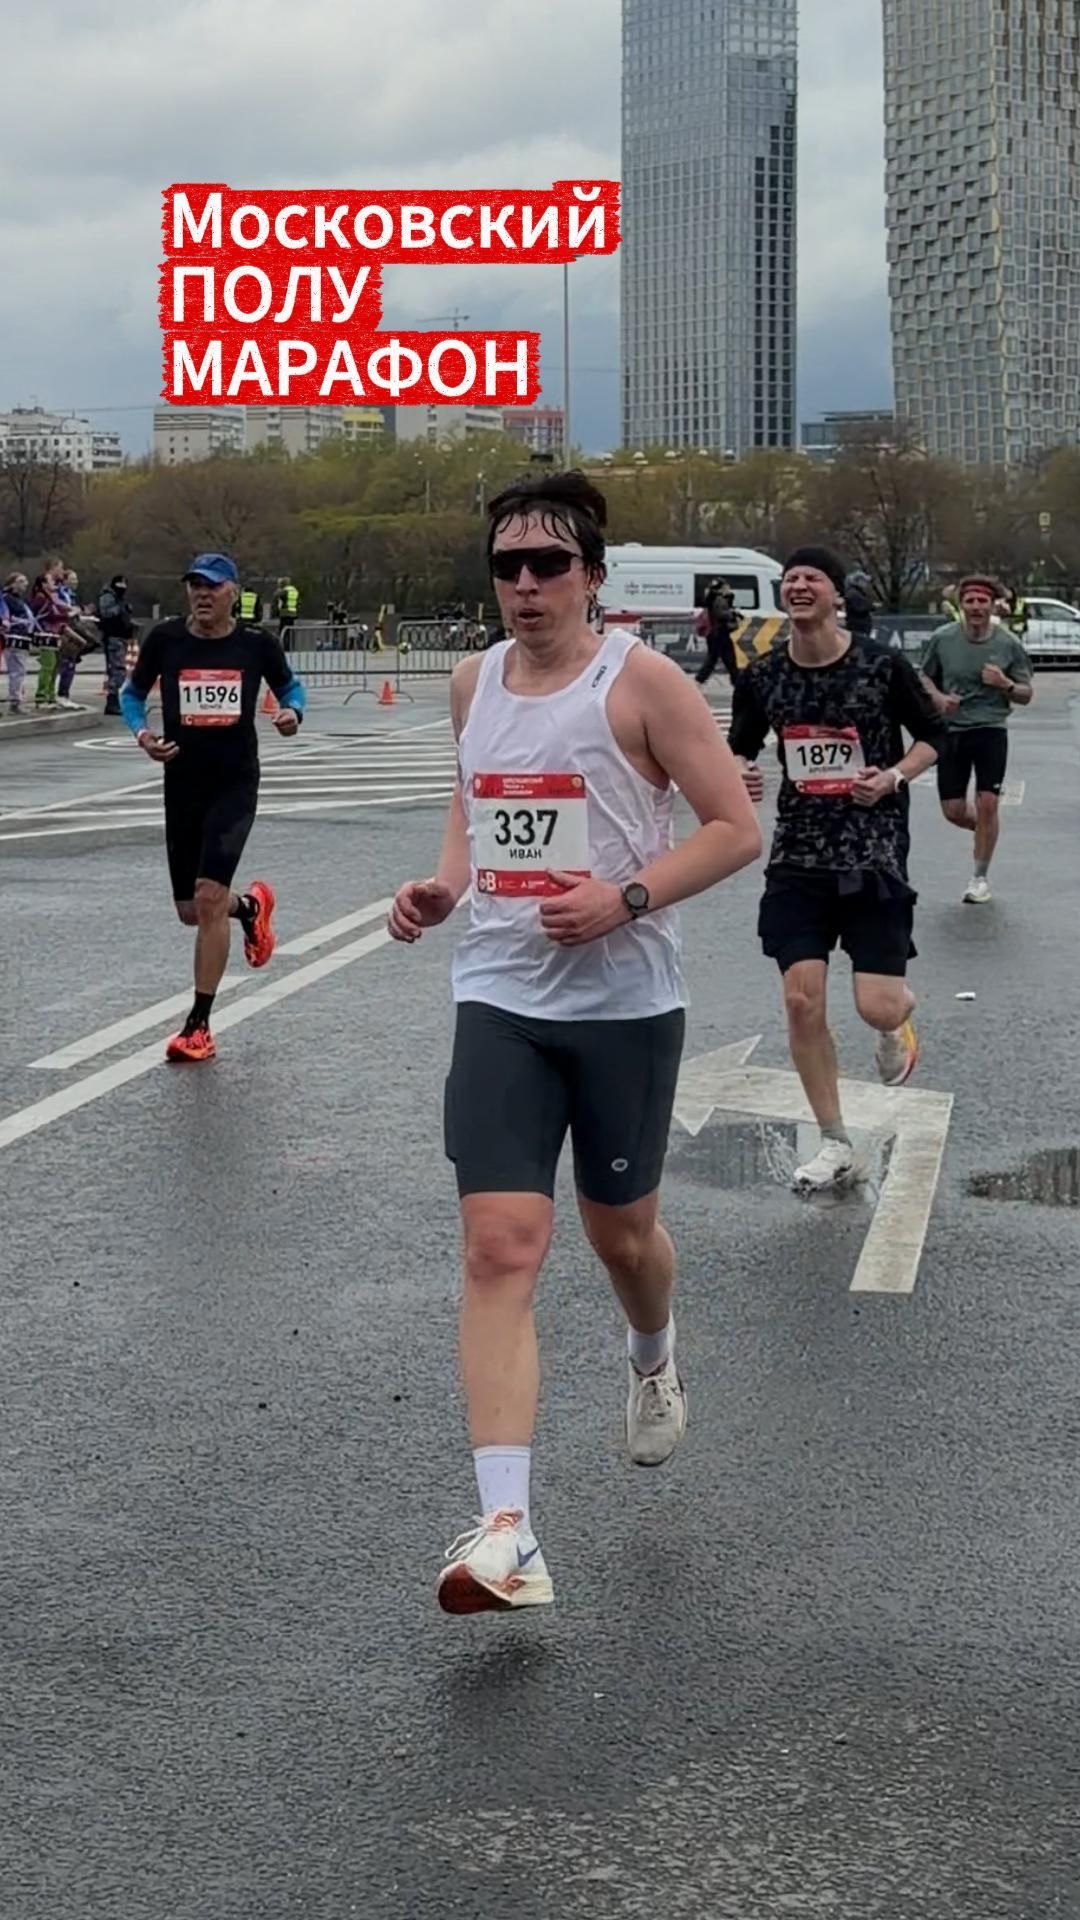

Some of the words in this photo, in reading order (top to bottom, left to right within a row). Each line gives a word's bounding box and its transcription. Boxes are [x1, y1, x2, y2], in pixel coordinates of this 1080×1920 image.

[183, 686, 239, 703] 11596
[796, 743, 853, 767] 1879
[494, 809, 559, 846] 337
[509, 848, 542, 860] ИВАН
